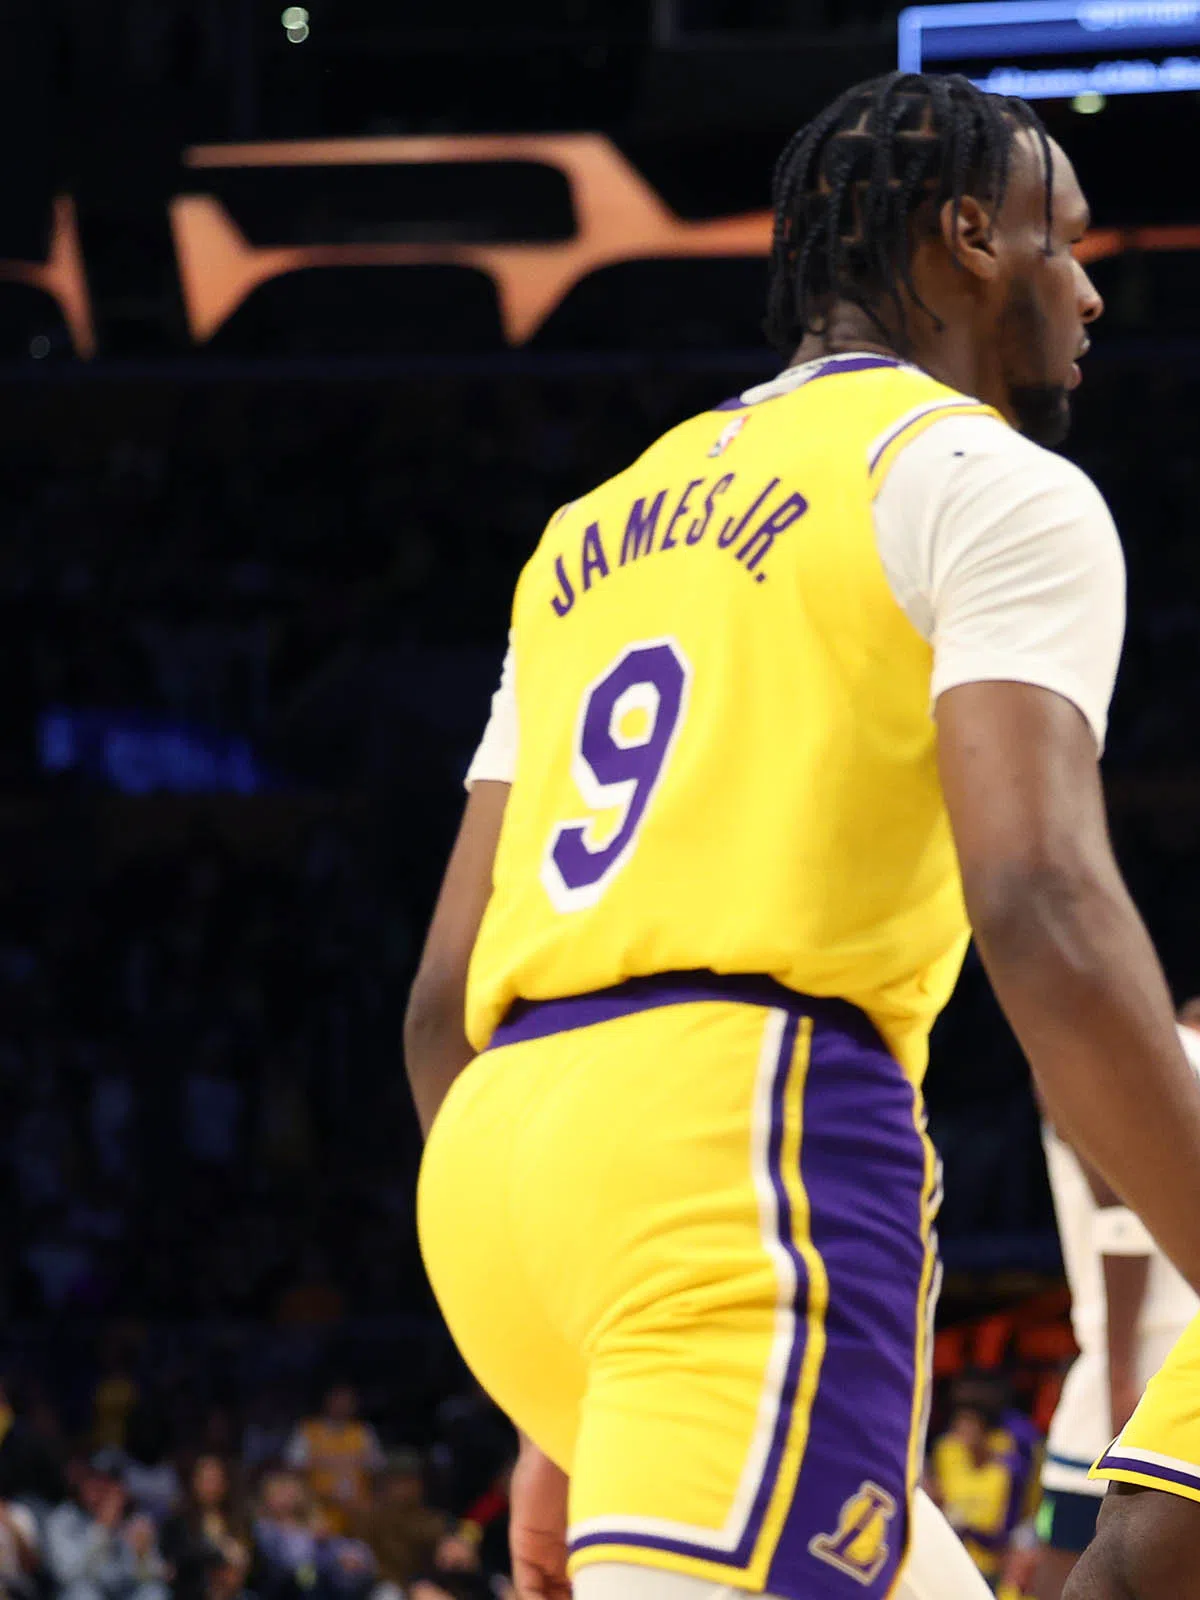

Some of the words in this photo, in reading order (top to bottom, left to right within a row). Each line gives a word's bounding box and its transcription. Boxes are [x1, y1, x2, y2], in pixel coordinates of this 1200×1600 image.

[550, 472, 736, 617] JAMES
[717, 476, 810, 584] JR.
[543, 637, 693, 908] 9
